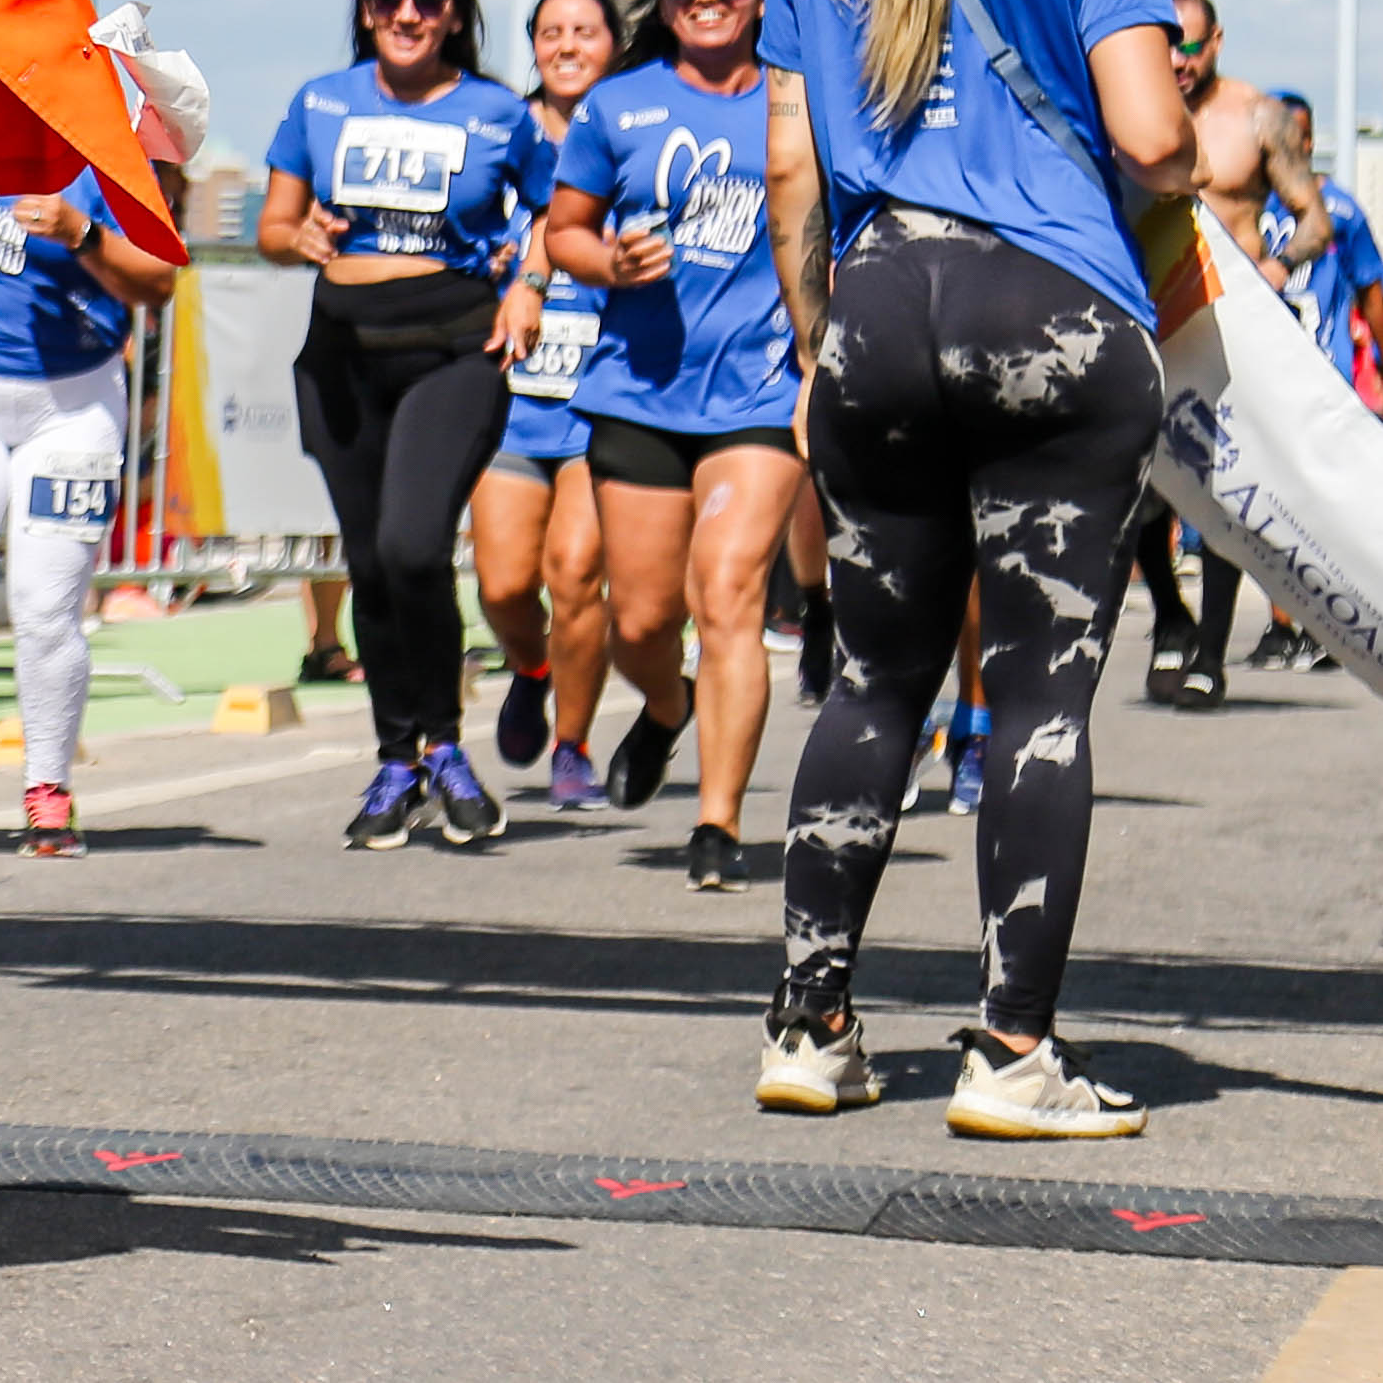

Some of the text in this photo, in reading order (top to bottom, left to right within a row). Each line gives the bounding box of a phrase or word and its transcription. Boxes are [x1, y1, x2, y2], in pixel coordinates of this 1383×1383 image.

[362, 147, 426, 185] 714
[51, 479, 106, 516] 154
[1220, 484, 1383, 667] ALAGOA
